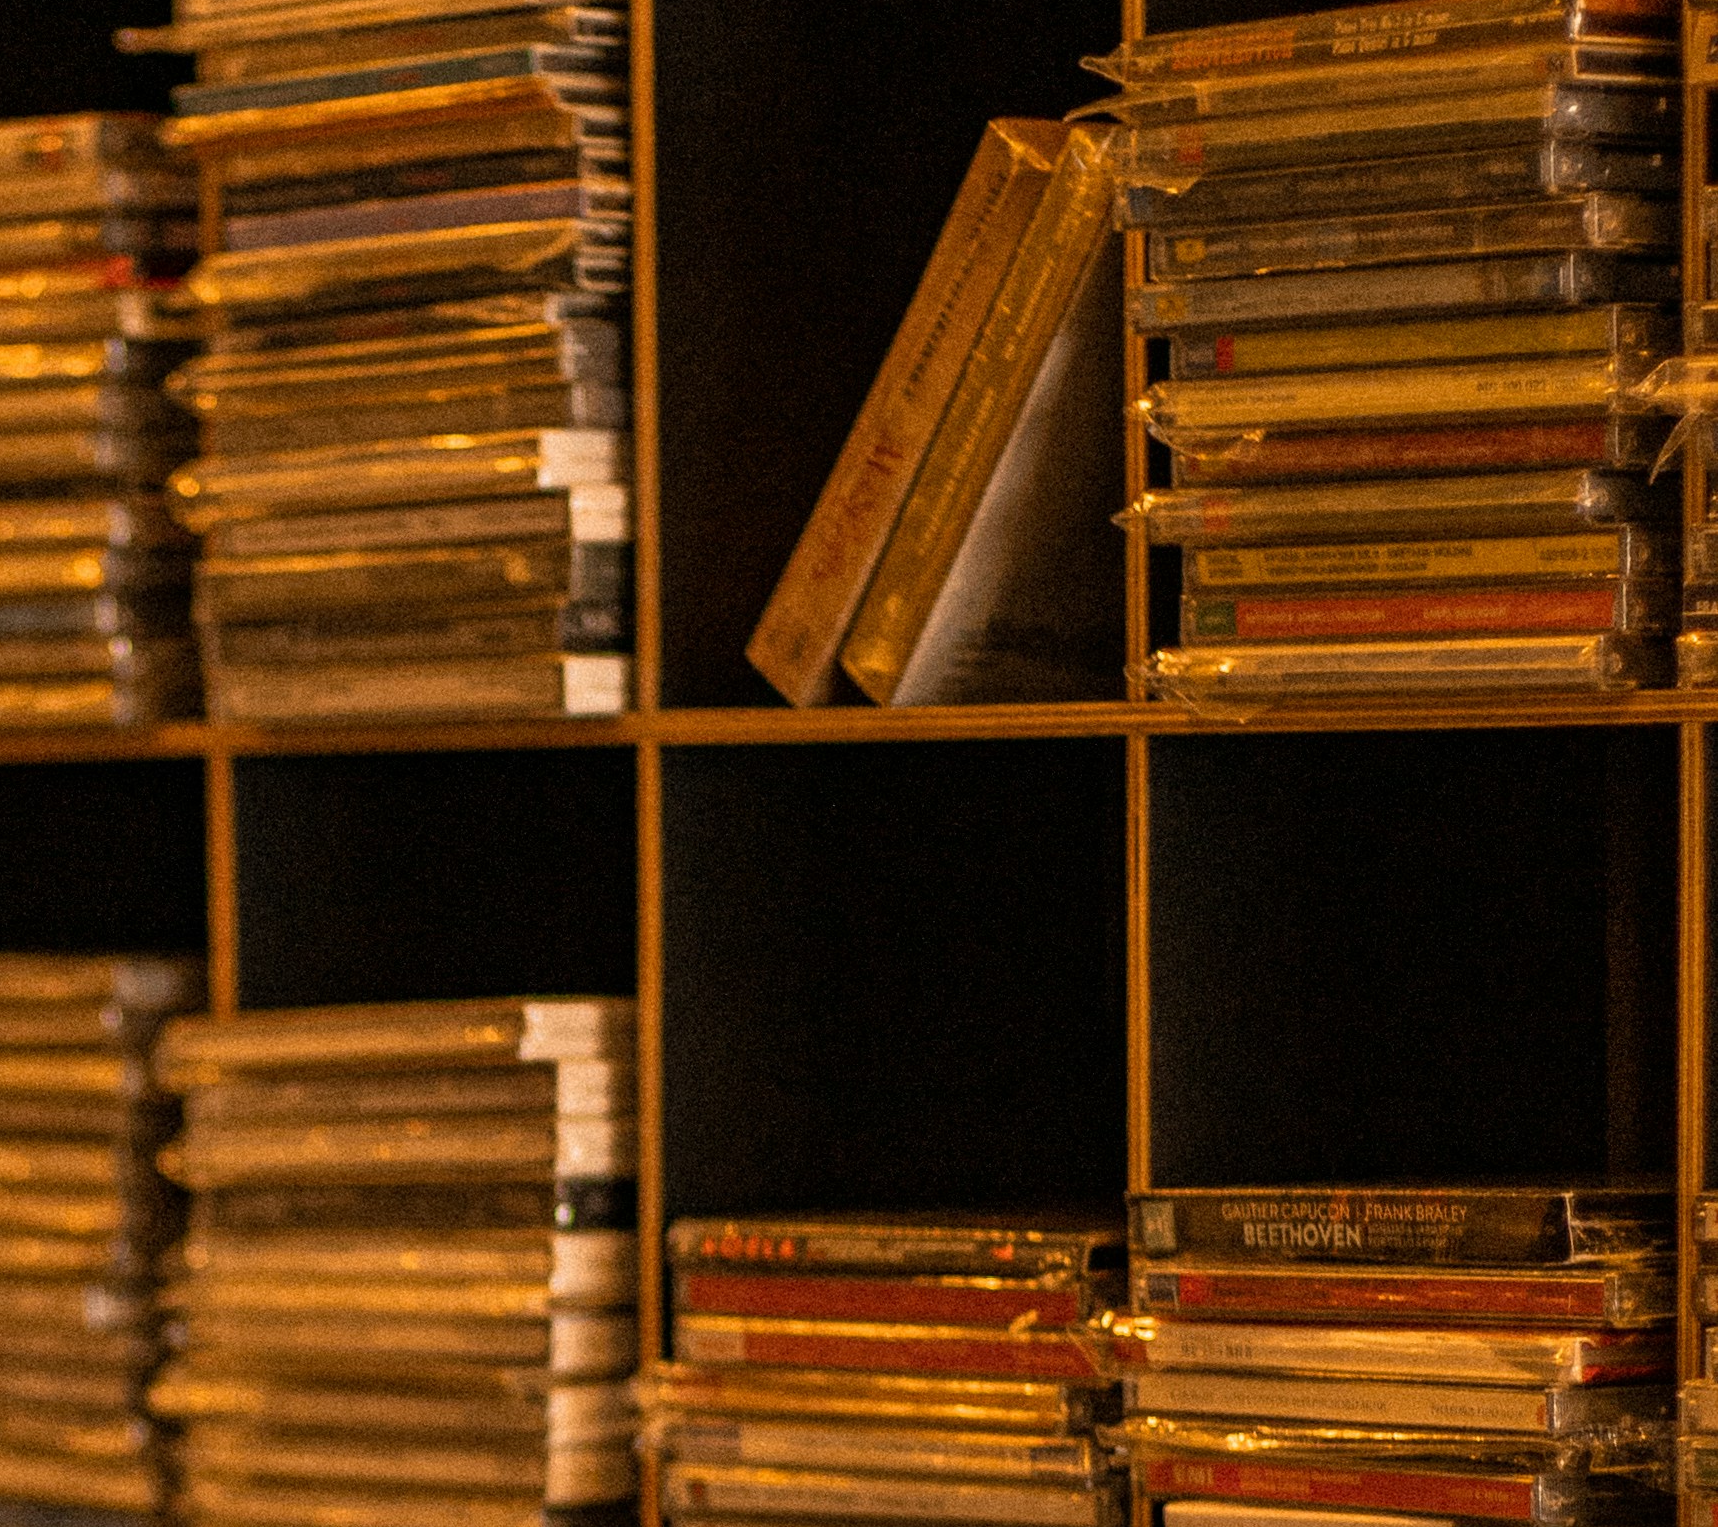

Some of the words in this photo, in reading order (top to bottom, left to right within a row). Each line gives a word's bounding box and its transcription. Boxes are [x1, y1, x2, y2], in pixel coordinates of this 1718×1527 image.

[1221, 1201, 1279, 1221] GAUTIER
[1365, 1203, 1414, 1221] FRANK
[1415, 1204, 1469, 1222] BRALEY
[1242, 1222, 1363, 1249] BEETHOVEN
